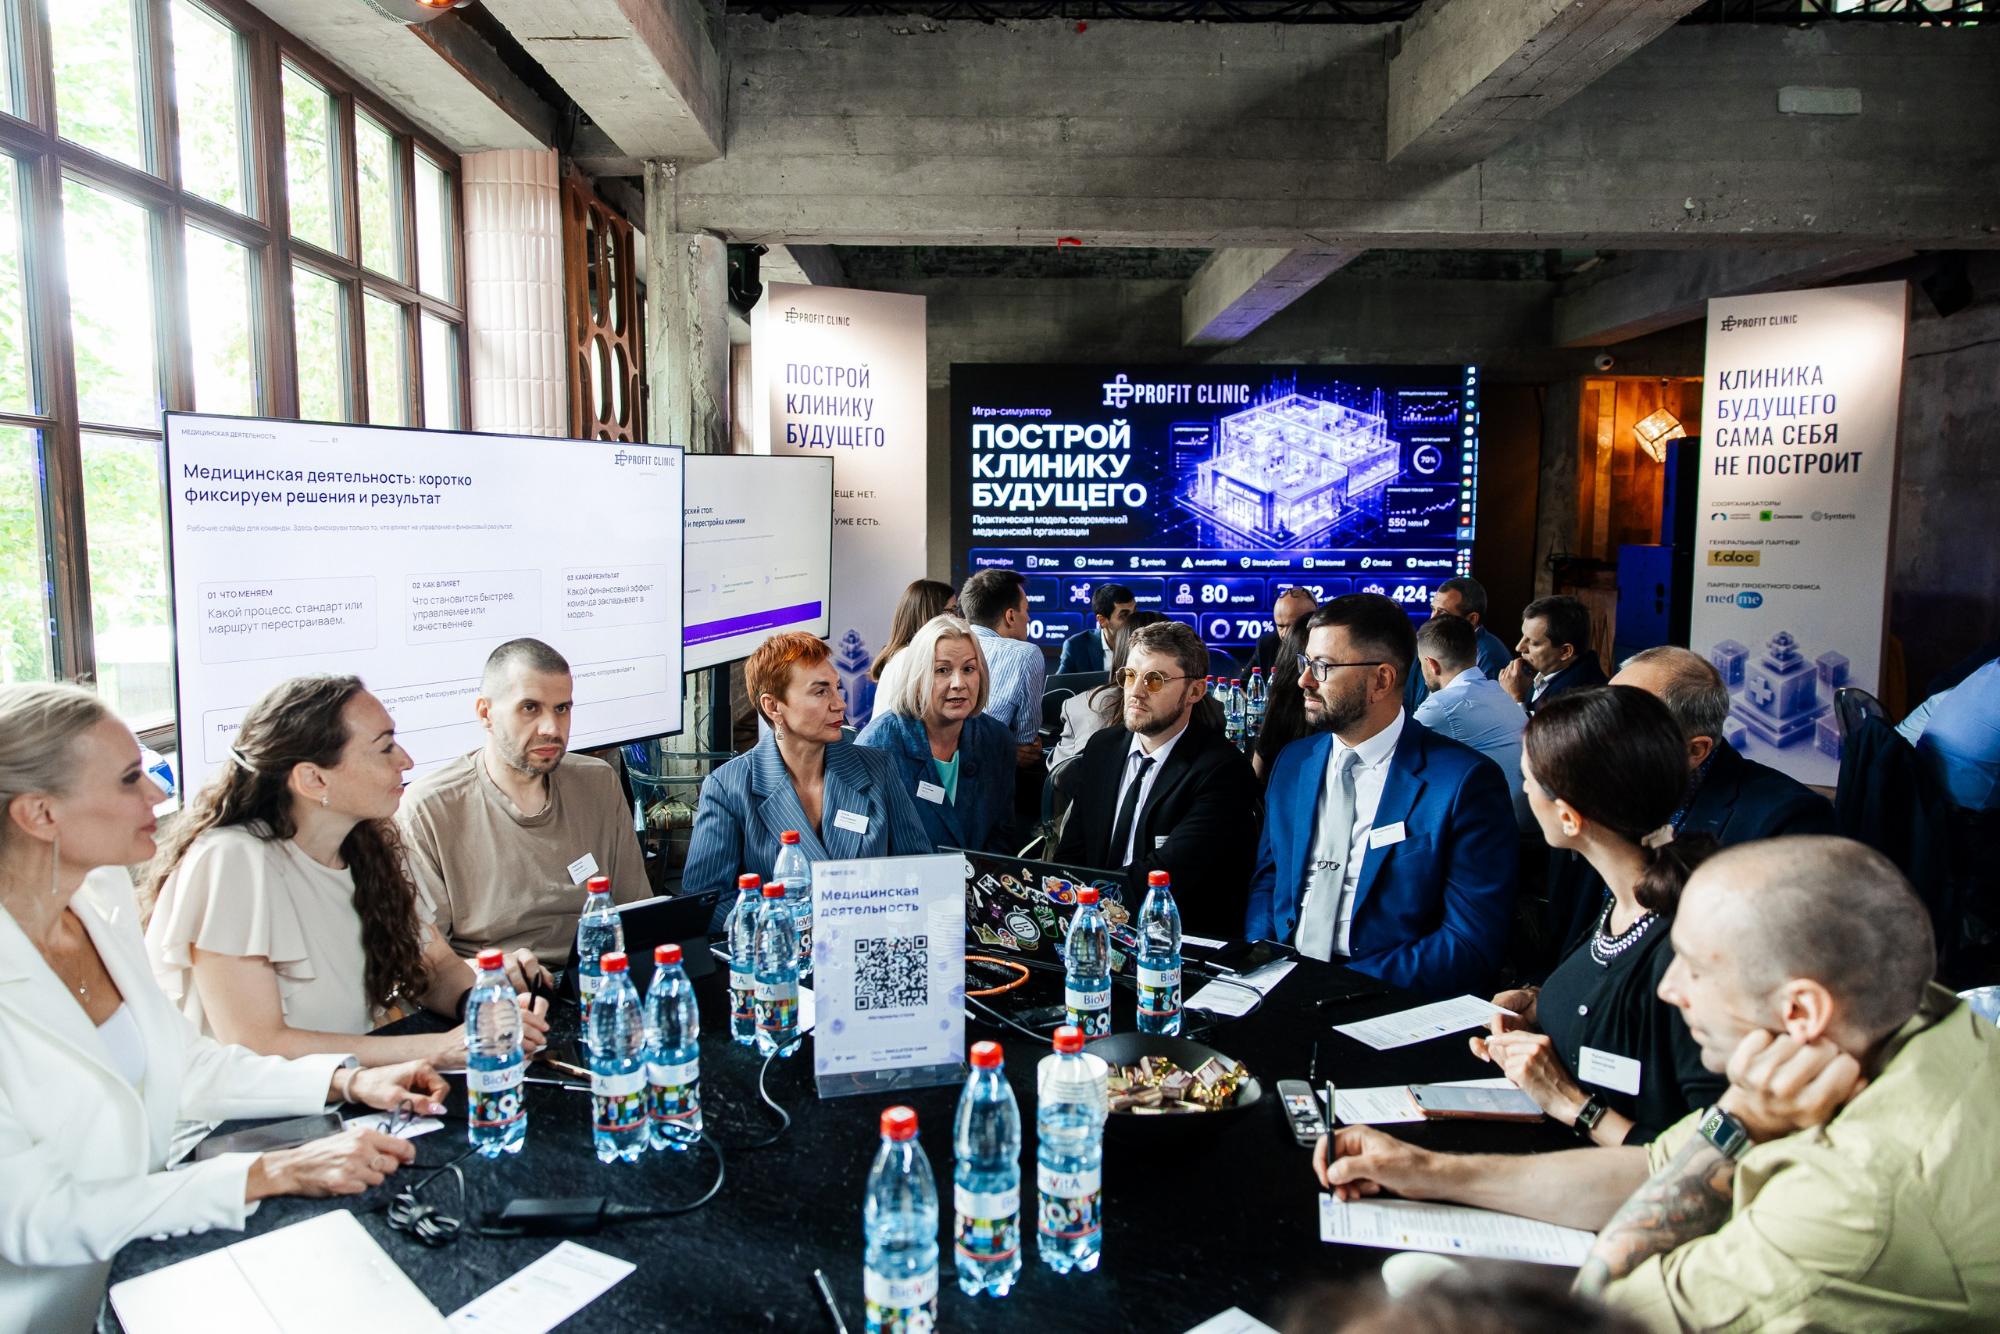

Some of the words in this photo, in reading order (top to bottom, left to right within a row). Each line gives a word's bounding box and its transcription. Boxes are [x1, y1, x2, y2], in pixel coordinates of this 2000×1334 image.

[800, 313, 824, 325] PROFIT
[827, 315, 850, 327] CLINIC
[1737, 316, 1767, 328] PROFIT
[1769, 314, 1798, 326] CLINIC
[786, 363, 870, 388] ПОСТРОЙ
[1719, 365, 1823, 391] КЛИНИКА
[1135, 384, 1192, 404] PROFIT
[1197, 384, 1250, 404] CLINIC
[786, 393, 874, 421] КЛИНИКУ
[972, 406, 1052, 418] Игра-симулятор
[1718, 393, 1836, 422] БУДУЩЕГО
[786, 423, 885, 449] БУДУЩЕГО
[972, 419, 1131, 449] ПОСТРОЙ
[1716, 426, 1774, 448] САМА
[1782, 423, 1838, 445] СЕБЯ
[628, 455, 651, 466] PROFIT
[654, 456, 675, 467] CLINIC
[972, 453, 1131, 478] КЛИНИКУ
[1714, 456, 1740, 476] НЕ
[1747, 451, 1863, 475] ПОСТРОИТ
[184, 463, 303, 481] Медицинская
[307, 470, 415, 485] деятельность:
[419, 474, 472, 489] коротко
[184, 486, 282, 506] фиксируем
[286, 490, 355, 506] решения
[359, 493, 367, 503] и
[371, 493, 441, 507] результат
[834, 490, 854, 499] ЕЩЕ
[858, 490, 877, 499] НЕТ.
[972, 483, 1148, 511] БУДУЩЕГО
[684, 506, 699, 515] рский
[834, 518, 854, 526] УЖЕ
[857, 518, 880, 526] ЕСТЬ.
[973, 515, 1034, 525] Практическая
[1035, 516, 1068, 525] модель
[1069, 515, 1128, 525] современной
[1388, 518, 1406, 527] 550
[973, 527, 1032, 537] медицинской
[1033, 528, 1089, 537] организации
[1714, 551, 1754, 562] f.doc
[437, 580, 460, 588] ВЛИЯЕТ
[567, 587, 587, 595] Какой
[219, 590, 237, 599] ЧТО
[238, 589, 273, 598] МЕНЯЕМ
[412, 595, 428, 605] Что
[430, 593, 478, 604] становится
[1201, 584, 1228, 603] 80
[1393, 585, 1428, 603] 424
[1706, 594, 1734, 604] med
[208, 606, 242, 619] Какой
[295, 602, 342, 614] стандарт
[344, 601, 362, 610] или
[412, 607, 469, 621] управляемее
[470, 606, 485, 615] или
[209, 622, 259, 636] маршрут
[261, 616, 345, 632] перестраиваем.
[1027, 620, 1044, 639] 0
[1236, 620, 1274, 639] 70%
[821, 886, 920, 901] Медицинская
[820, 902, 920, 917] деятельность
